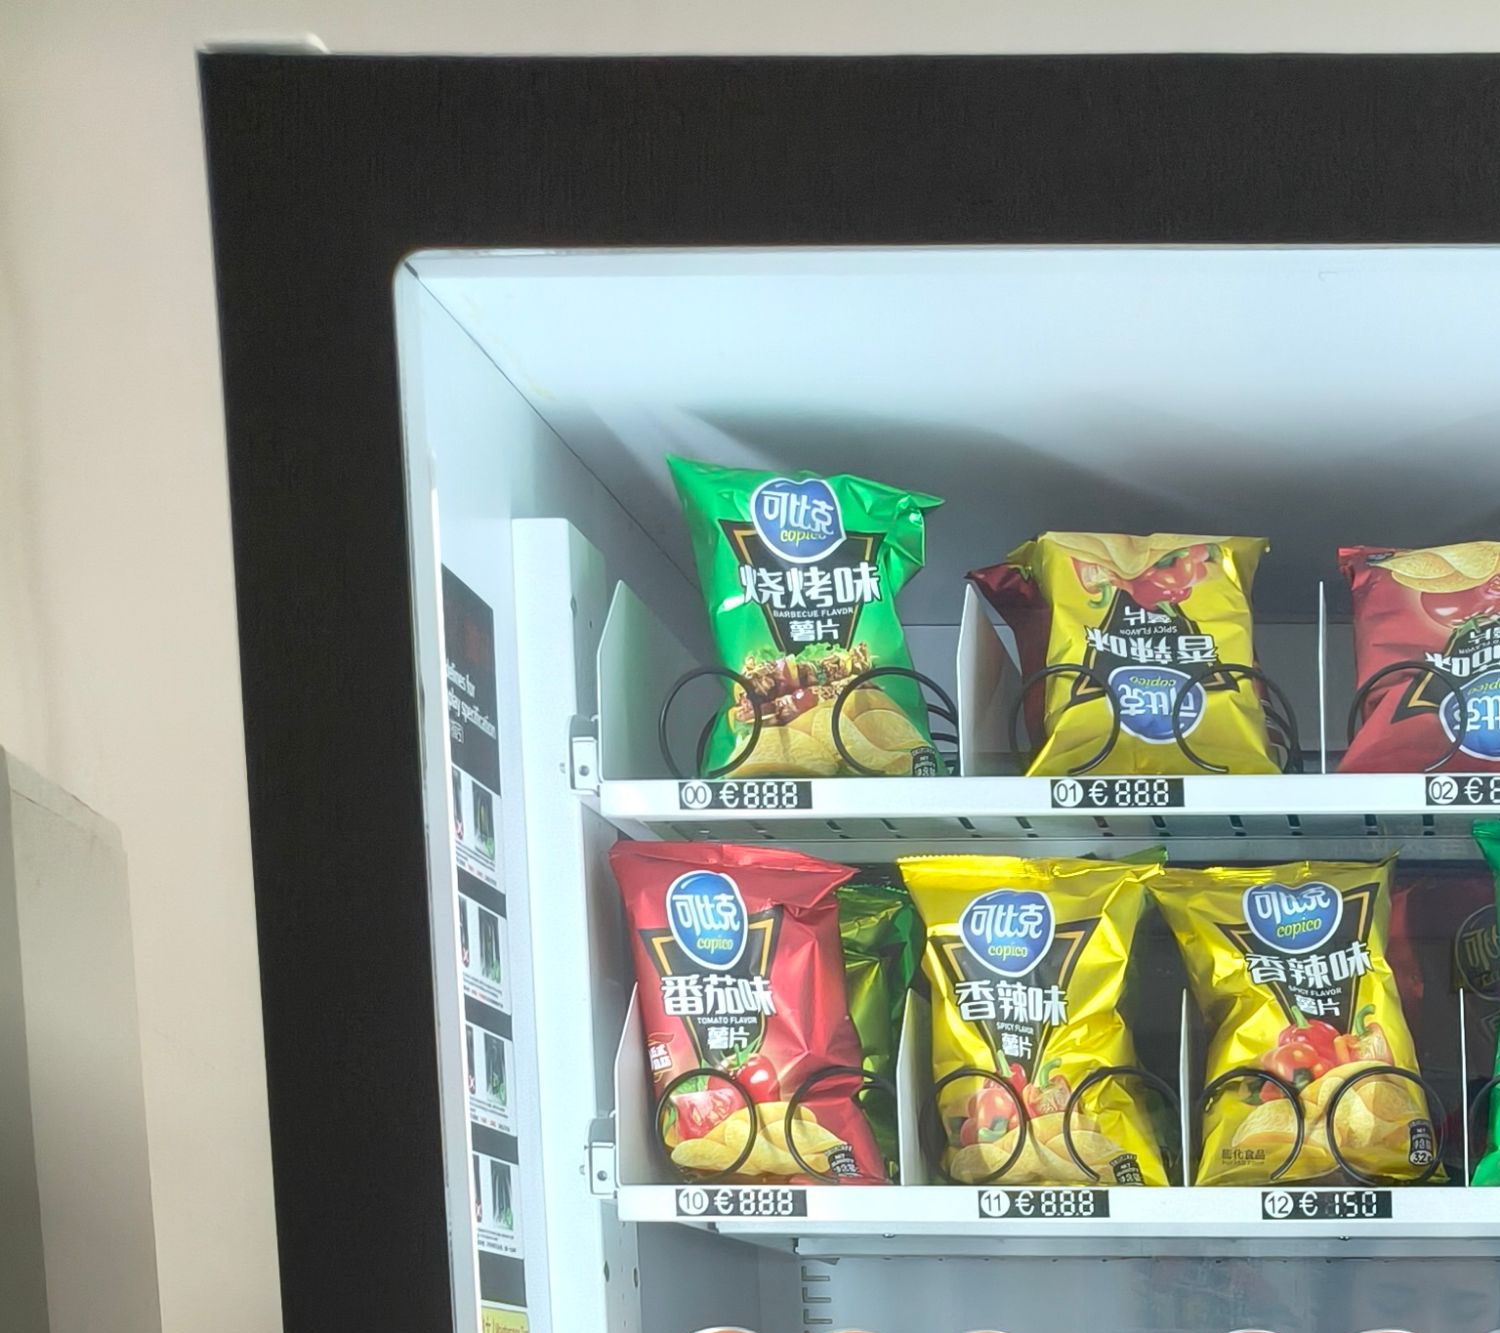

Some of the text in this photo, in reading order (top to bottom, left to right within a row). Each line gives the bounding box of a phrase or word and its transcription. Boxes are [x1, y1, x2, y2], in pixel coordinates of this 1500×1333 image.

[740, 562, 881, 609] 烧烤味
[789, 619, 840, 642] 薯片
[683, 786, 707, 802] 00
[1056, 784, 1079, 802] 01
[1432, 782, 1453, 799] 02
[1276, 917, 1322, 940] copico
[696, 936, 734, 954] copico
[988, 943, 1028, 961] copico
[1246, 941, 1374, 989] 香辣味
[661, 974, 777, 1016] 番茄味
[956, 979, 1068, 1027] 香辣味
[707, 1026, 750, 1050] 薯片
[1001, 1032, 1033, 1060] 薯片
[685, 1192, 703, 1208] 10
[985, 1195, 1001, 1211] 11
[1269, 1197, 1288, 1213] 12
